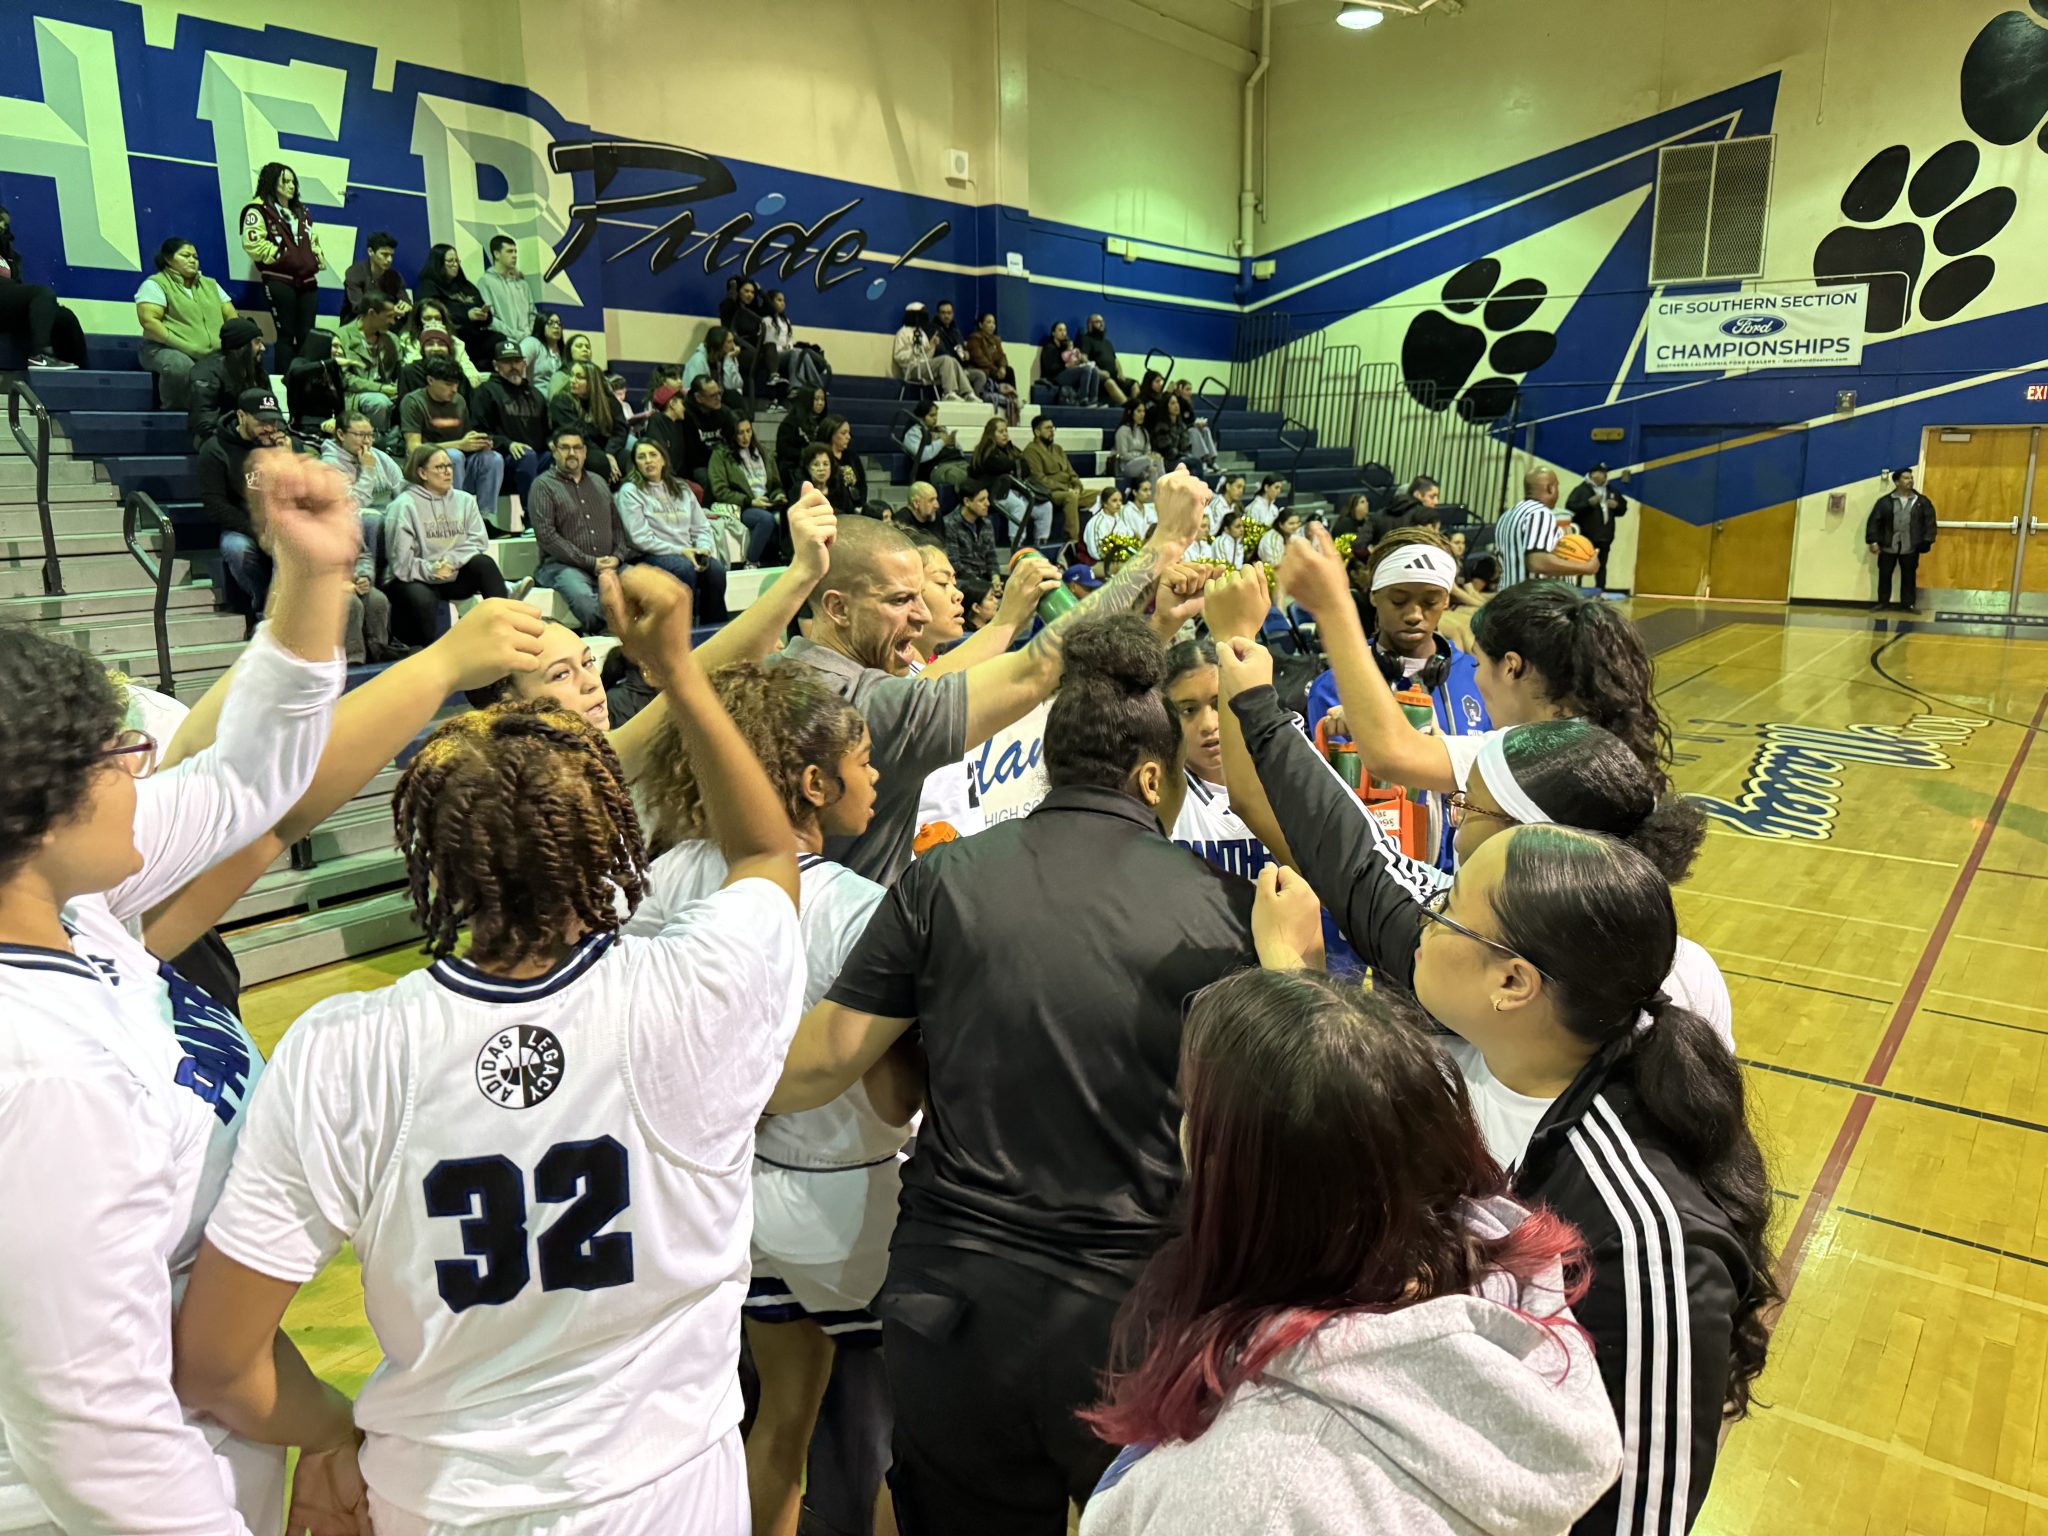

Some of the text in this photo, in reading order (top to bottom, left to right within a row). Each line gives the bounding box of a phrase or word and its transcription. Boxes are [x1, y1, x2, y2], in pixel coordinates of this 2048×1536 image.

[1658, 292, 1858, 315] CIF SOUTHERN SECTION
[1731, 316, 1775, 335] Ford
[1656, 337, 1851, 360] CHAMPIONSHIPS
[481, 1029, 560, 1103] ADIDAS LEGACY
[422, 1133, 635, 1315] 32
